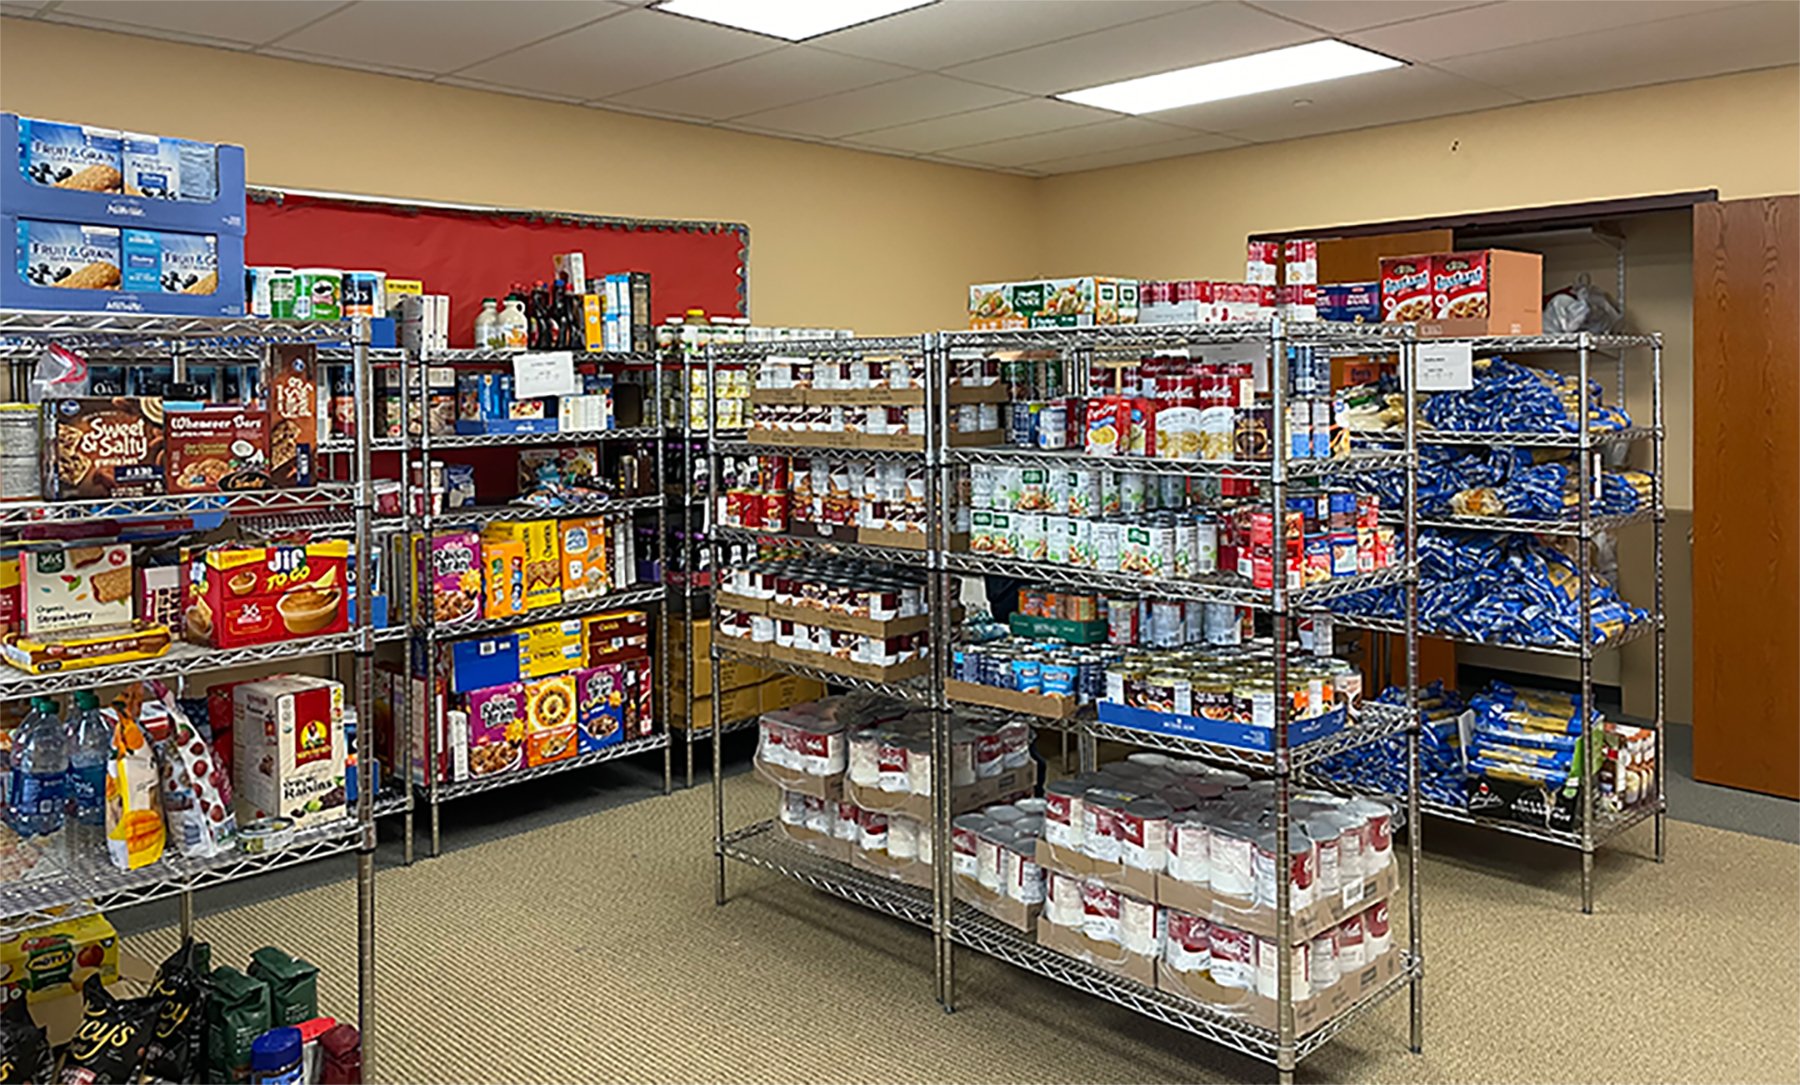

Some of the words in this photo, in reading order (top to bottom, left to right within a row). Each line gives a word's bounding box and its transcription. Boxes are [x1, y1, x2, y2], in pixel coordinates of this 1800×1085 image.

[90, 418, 145, 440] Sweet
[171, 416, 232, 430] Whenever
[232, 414, 262, 429] Bars
[81, 433, 98, 453] &
[99, 436, 148, 461] Salty
[36, 611, 93, 625] Strawberry
[240, 602, 260, 617] 36
[283, 780, 333, 800] Raisins
